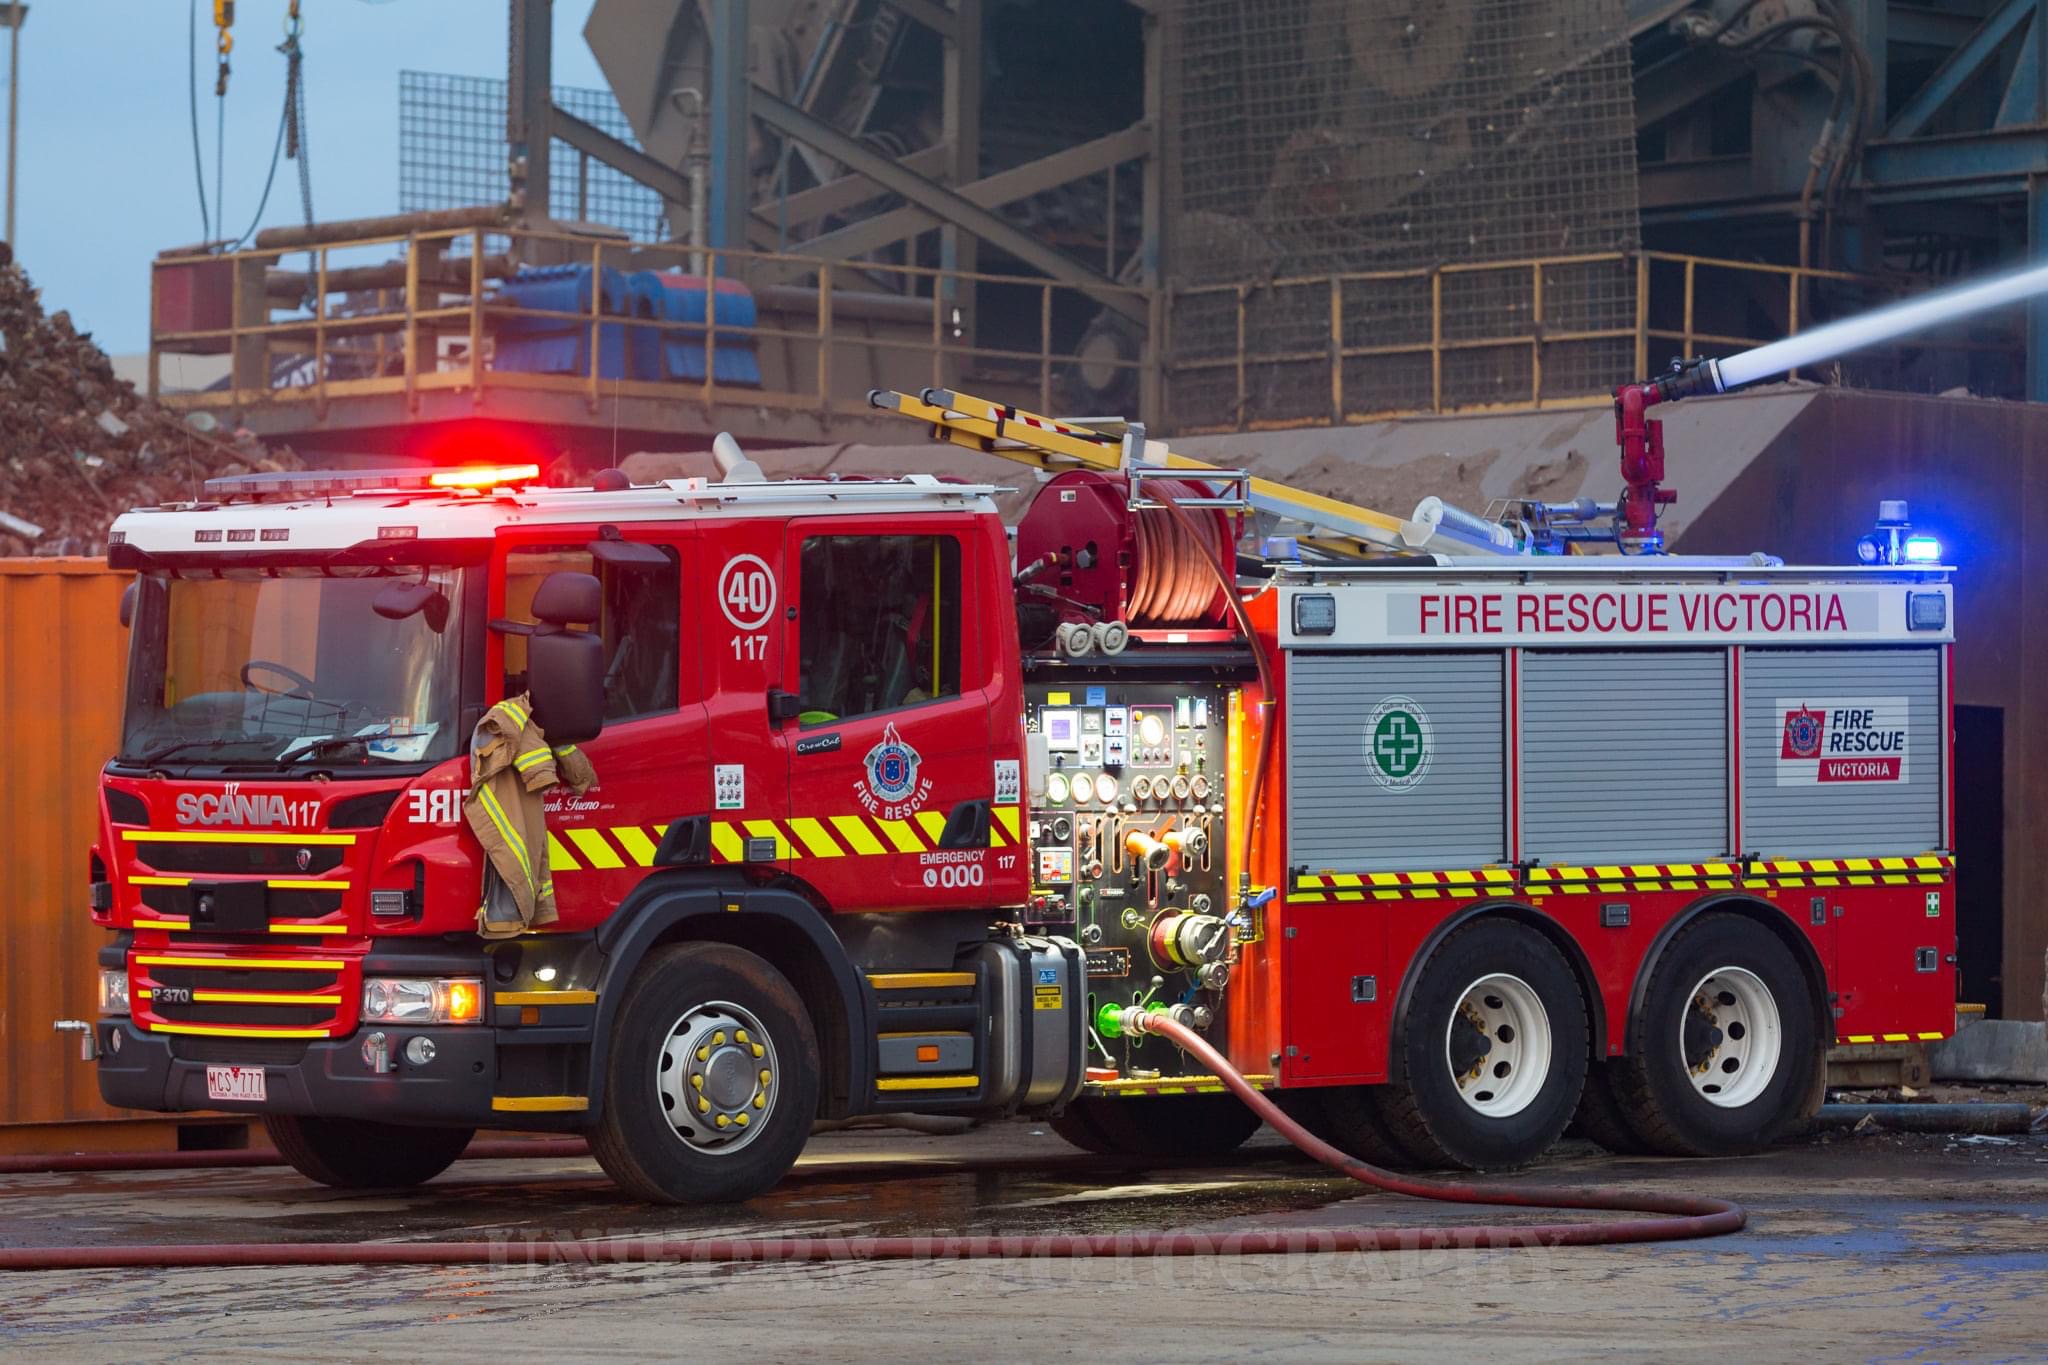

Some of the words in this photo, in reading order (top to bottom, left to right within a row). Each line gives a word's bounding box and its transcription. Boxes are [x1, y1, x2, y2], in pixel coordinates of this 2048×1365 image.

[727, 571, 767, 613] 40
[1419, 594, 1503, 633] FIRE
[1516, 593, 1668, 632] RESCUE
[1679, 592, 1848, 632] VICTORIA
[731, 635, 768, 661] 117
[1832, 709, 1875, 730] FIRE
[797, 737, 841, 752] CrewCab
[1829, 731, 1905, 752] RESCUE
[1828, 762, 1890, 777] VICTORIA
[224, 782, 240, 795] 117
[853, 780, 880, 814] FIRE
[884, 777, 934, 820] RESCUE
[175, 793, 290, 826] SCANIA
[288, 801, 321, 827] 117
[920, 850, 985, 865] EMERGENCY
[997, 855, 1016, 869] 117
[941, 864, 984, 888] 000
[152, 988, 161, 1000] P
[163, 988, 189, 1002] 370
[208, 1071, 231, 1092] MCS
[240, 1072, 262, 1093] 777
